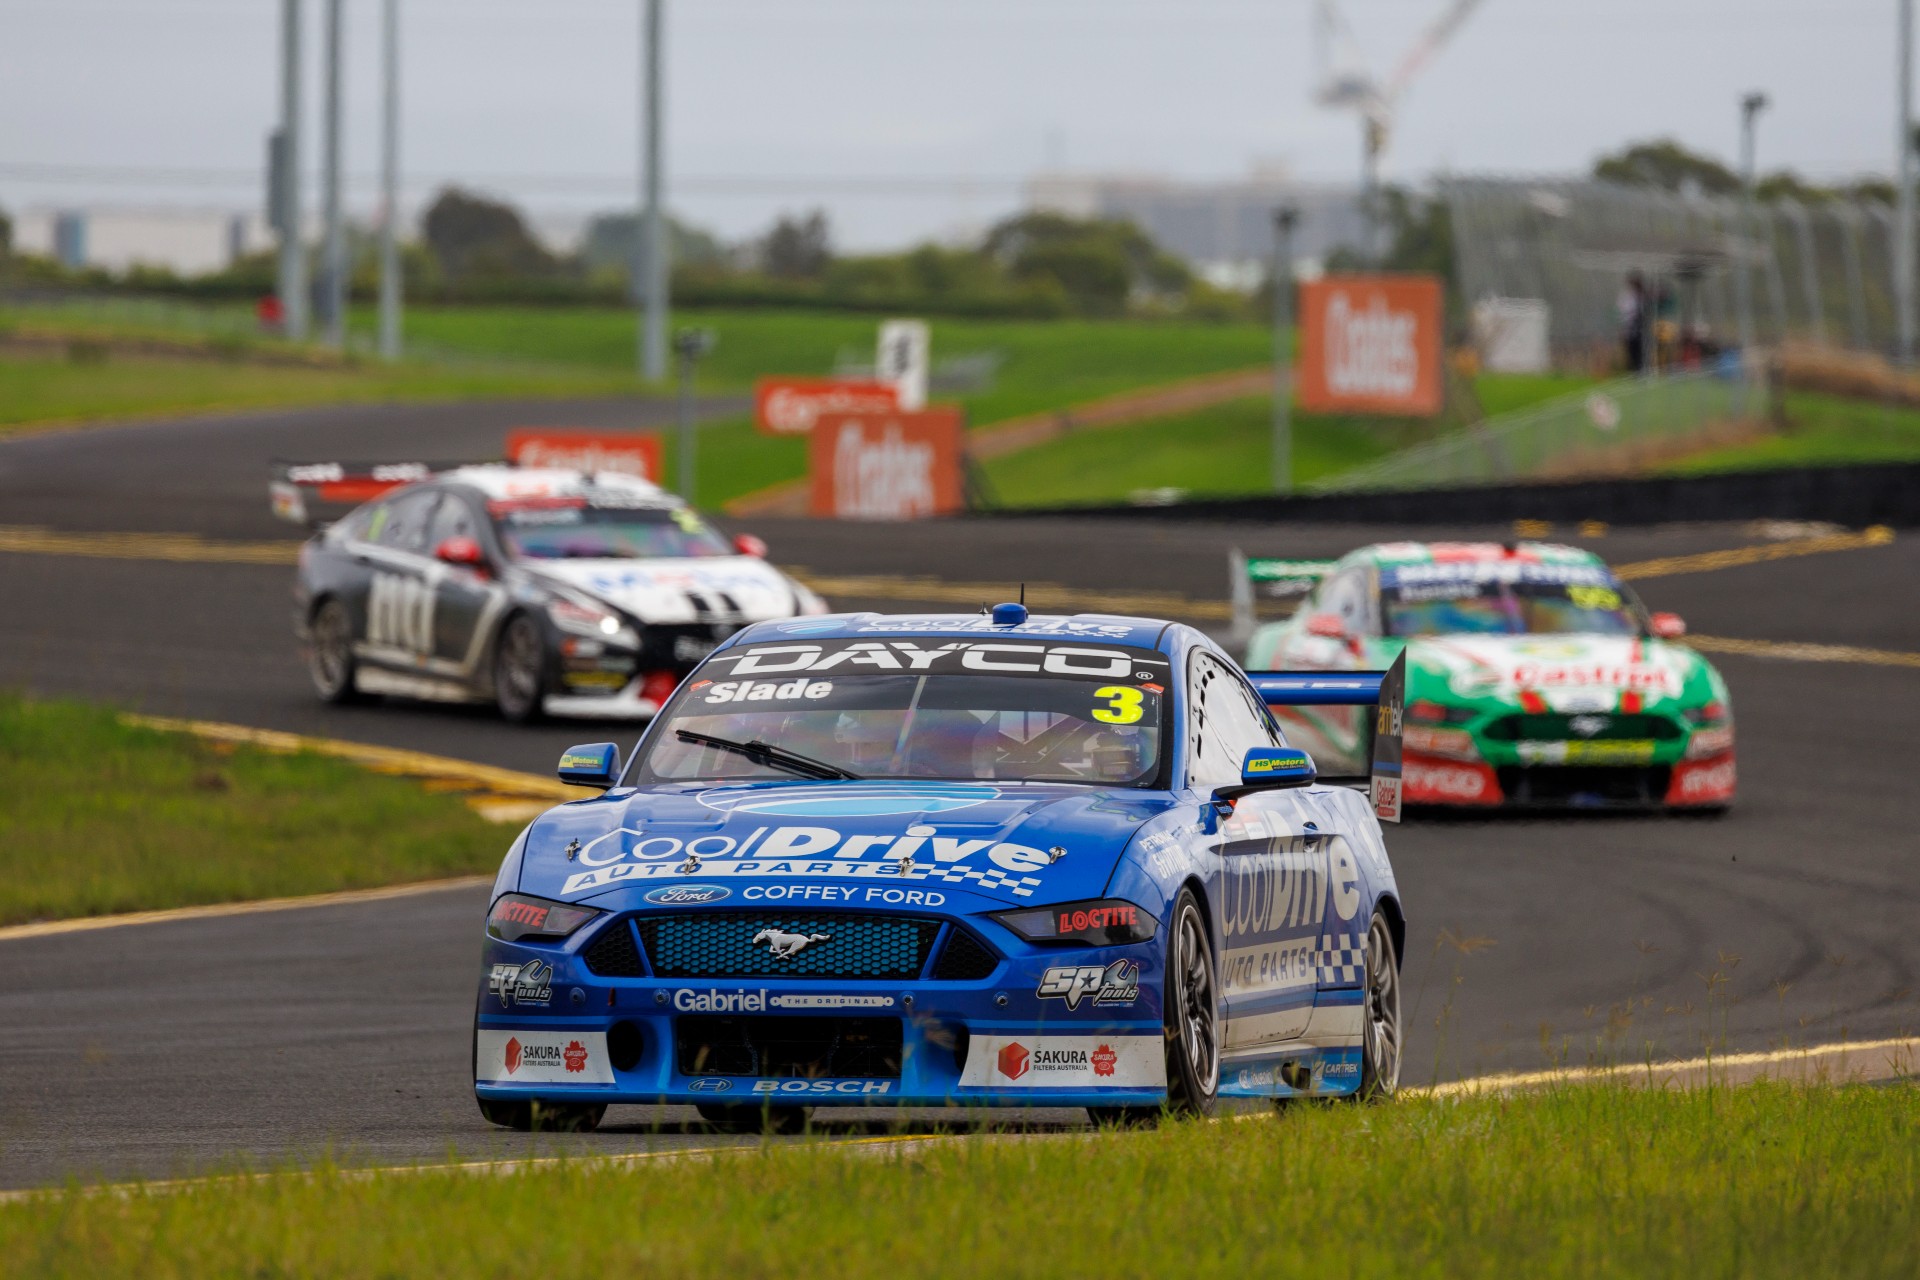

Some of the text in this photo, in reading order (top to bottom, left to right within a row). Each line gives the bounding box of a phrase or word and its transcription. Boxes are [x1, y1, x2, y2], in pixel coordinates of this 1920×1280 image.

[730, 643, 1132, 678] DAYCO
[1512, 664, 1668, 689] Castrol
[704, 678, 833, 704] Slade
[1091, 686, 1144, 724] 3
[1378, 701, 1403, 736] amtek
[1271, 758, 1305, 766] Motors
[1377, 779, 1397, 806] Gabriel
[579, 825, 1050, 872] CoolDrive
[575, 861, 902, 888] AUTO PARTS
[660, 888, 714, 902] Ford
[743, 886, 946, 907] COFFEY FORD
[1060, 906, 1136, 933] LOCTITE
[1260, 947, 1307, 979] PARTS
[515, 981, 552, 1004] tools
[674, 988, 766, 1012] Gabriel
[1039, 967, 1105, 1010] SP
[1093, 981, 1138, 1004] tools
[523, 1045, 561, 1059] SAKURA
[1034, 1050, 1087, 1063] SAKURA
[752, 1080, 891, 1093] BOSCH
